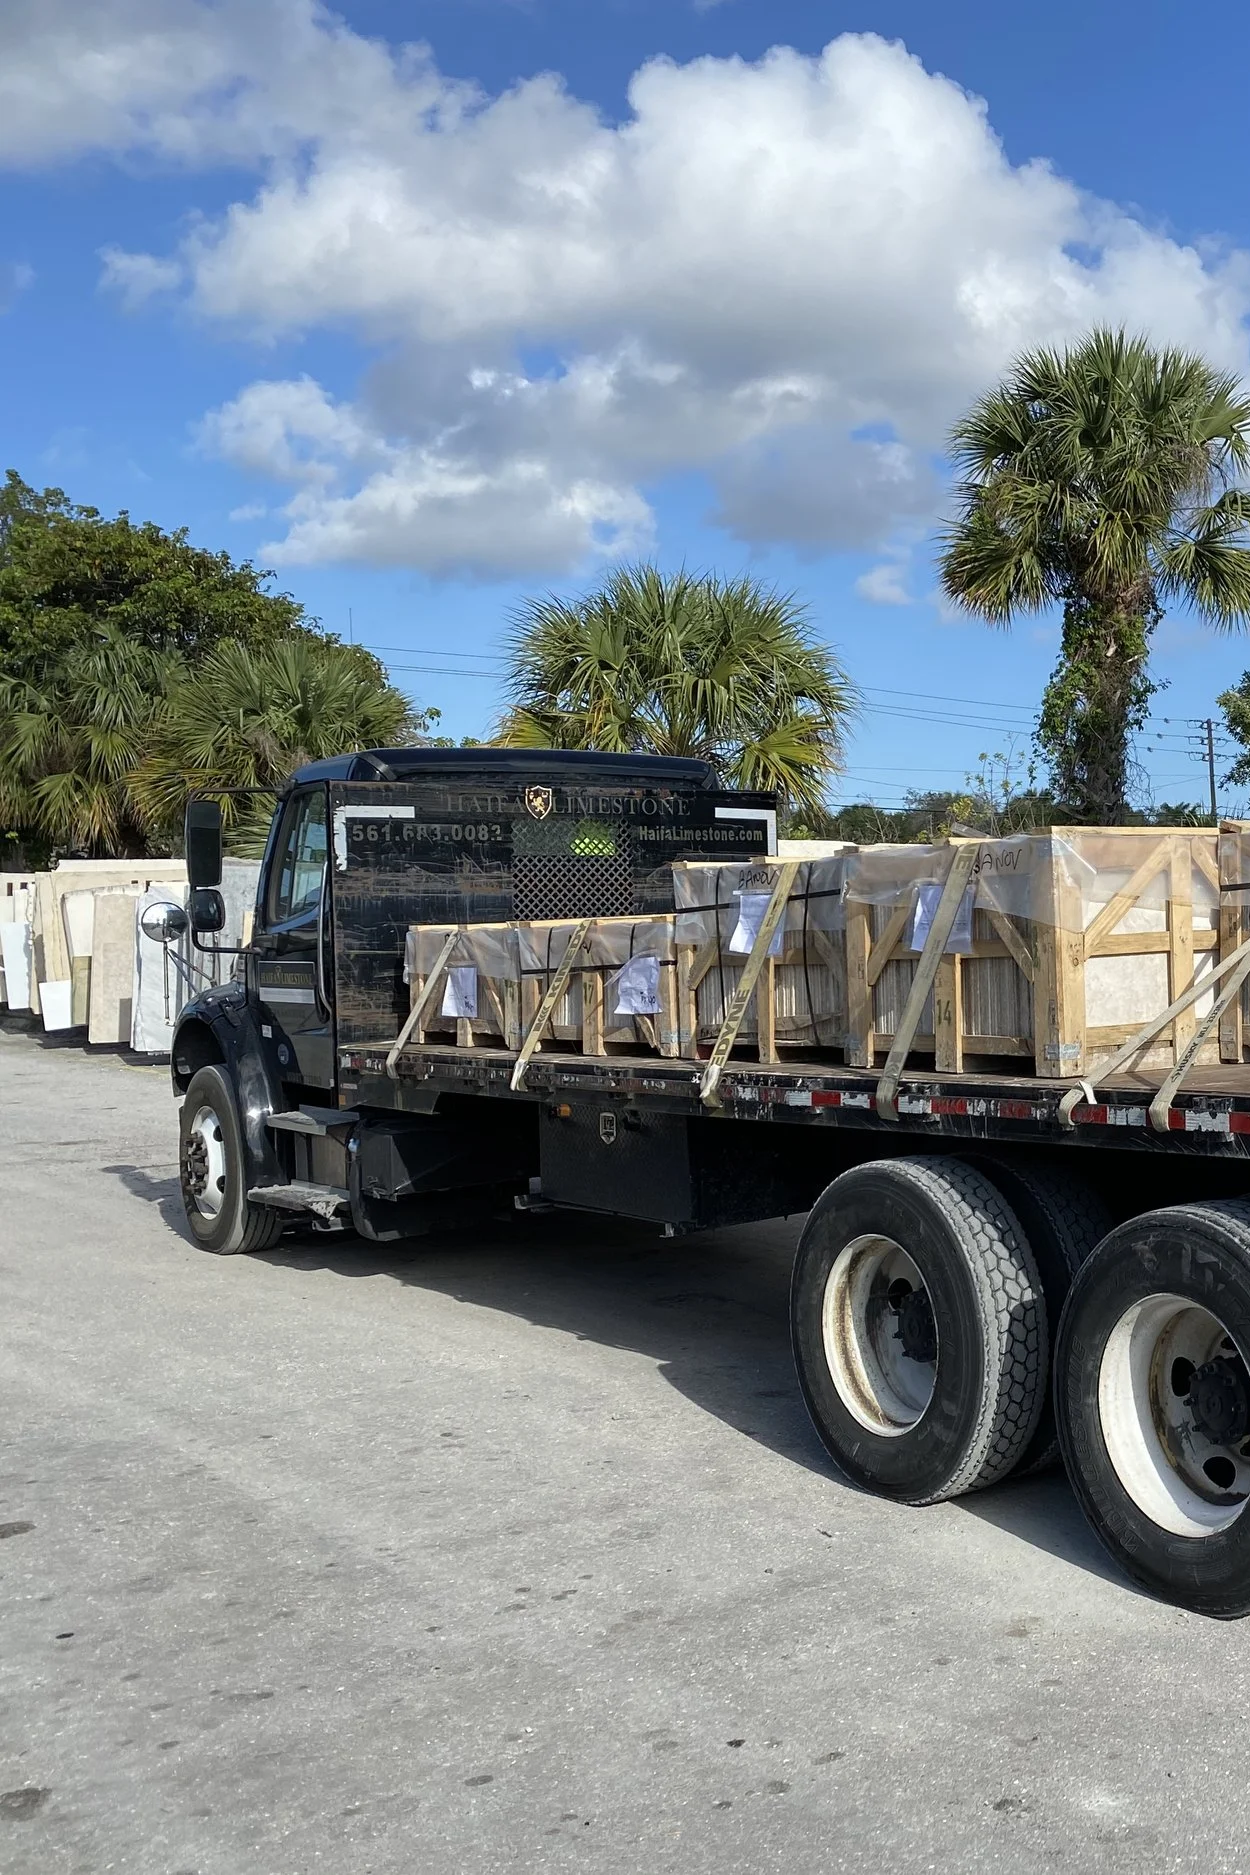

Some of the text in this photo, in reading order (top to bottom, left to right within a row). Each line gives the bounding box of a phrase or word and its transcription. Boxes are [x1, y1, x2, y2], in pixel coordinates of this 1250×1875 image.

[551, 796, 691, 816] LIMESTONE
[639, 826, 763, 841] HaifaLimestone.com
[936, 1000, 951, 1024] 14
